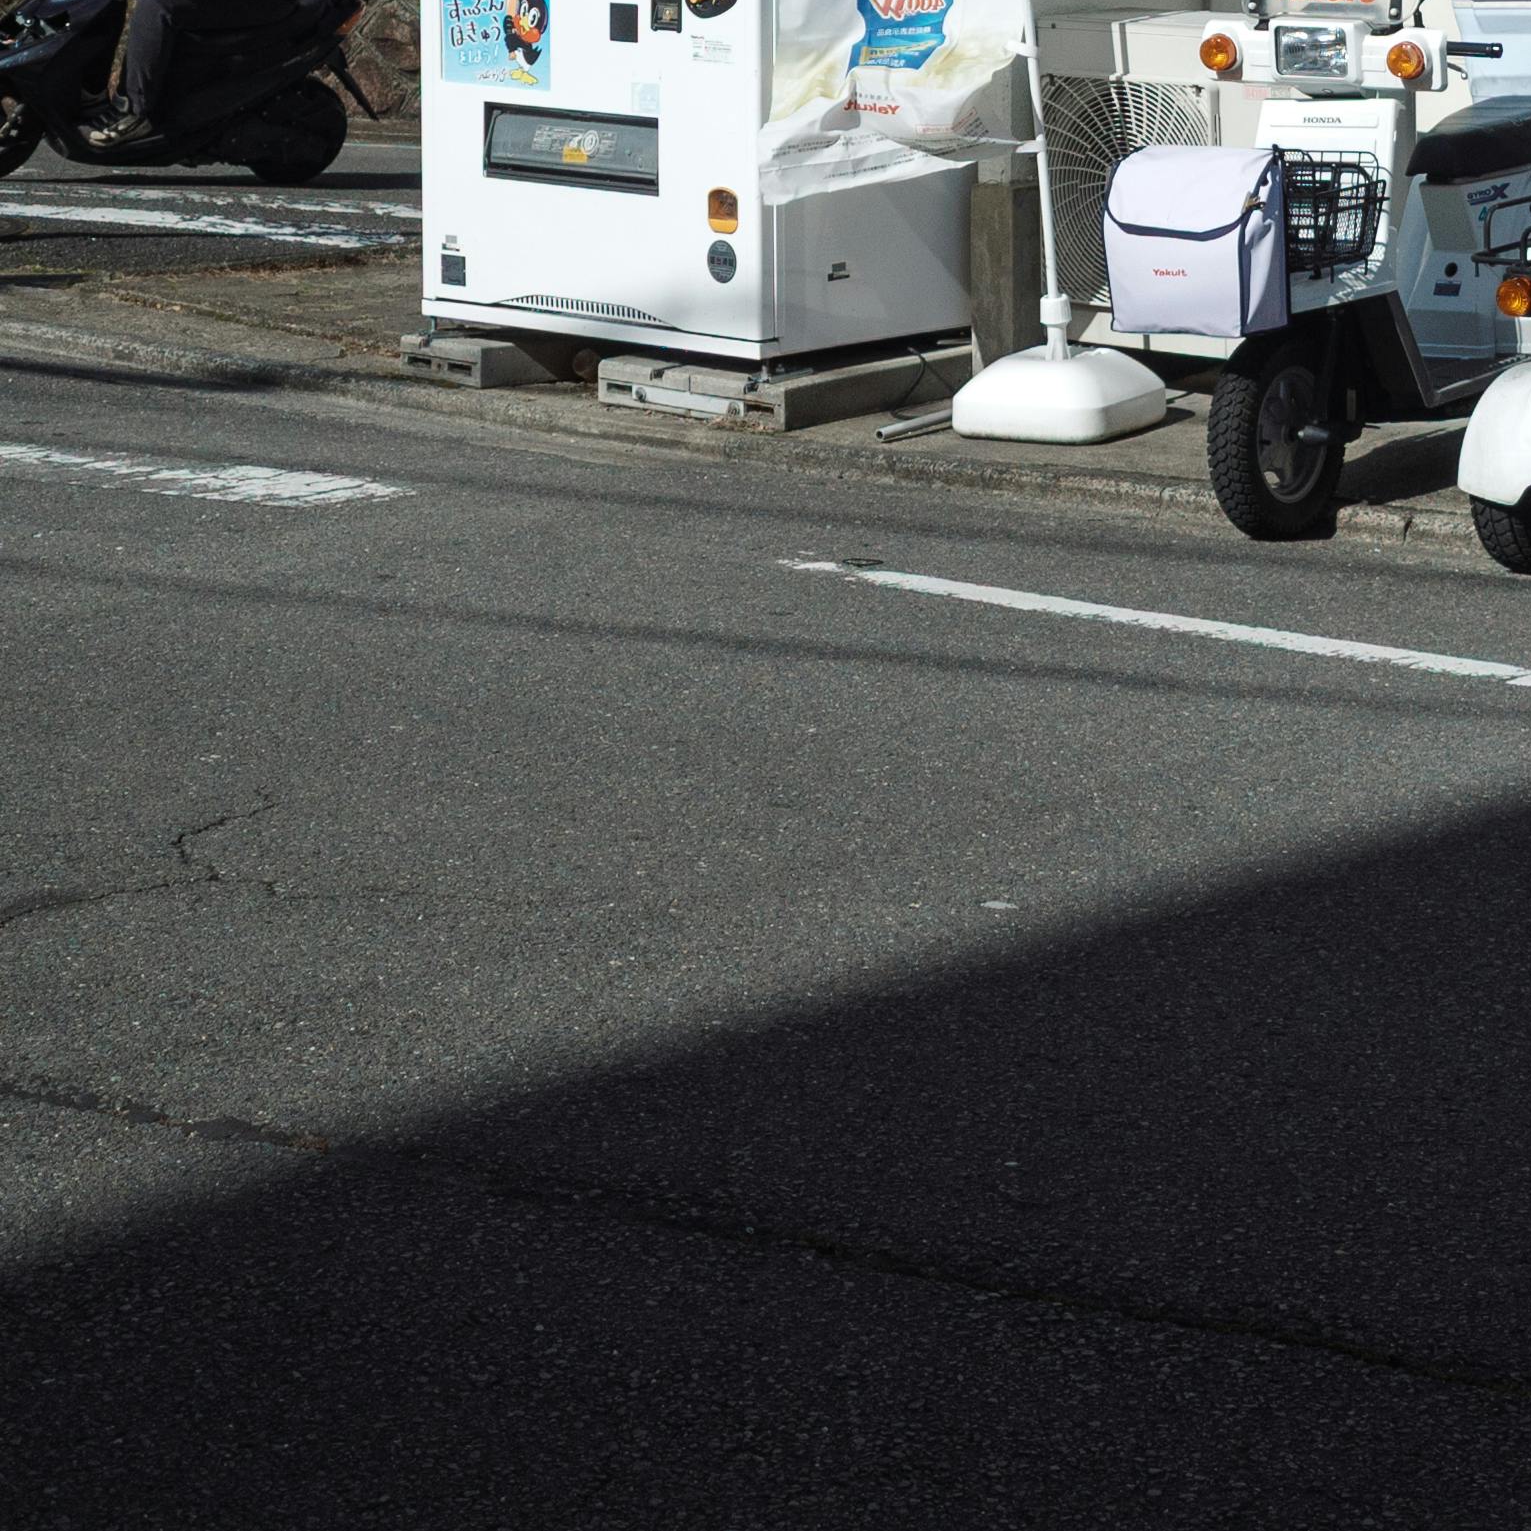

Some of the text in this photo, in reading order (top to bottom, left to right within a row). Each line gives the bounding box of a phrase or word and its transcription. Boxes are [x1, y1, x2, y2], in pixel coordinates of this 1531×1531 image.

[451, 16, 501, 47] ほきゅう
[1467, 188, 1491, 200] GYRO
[1153, 269, 1188, 277] Yakult
